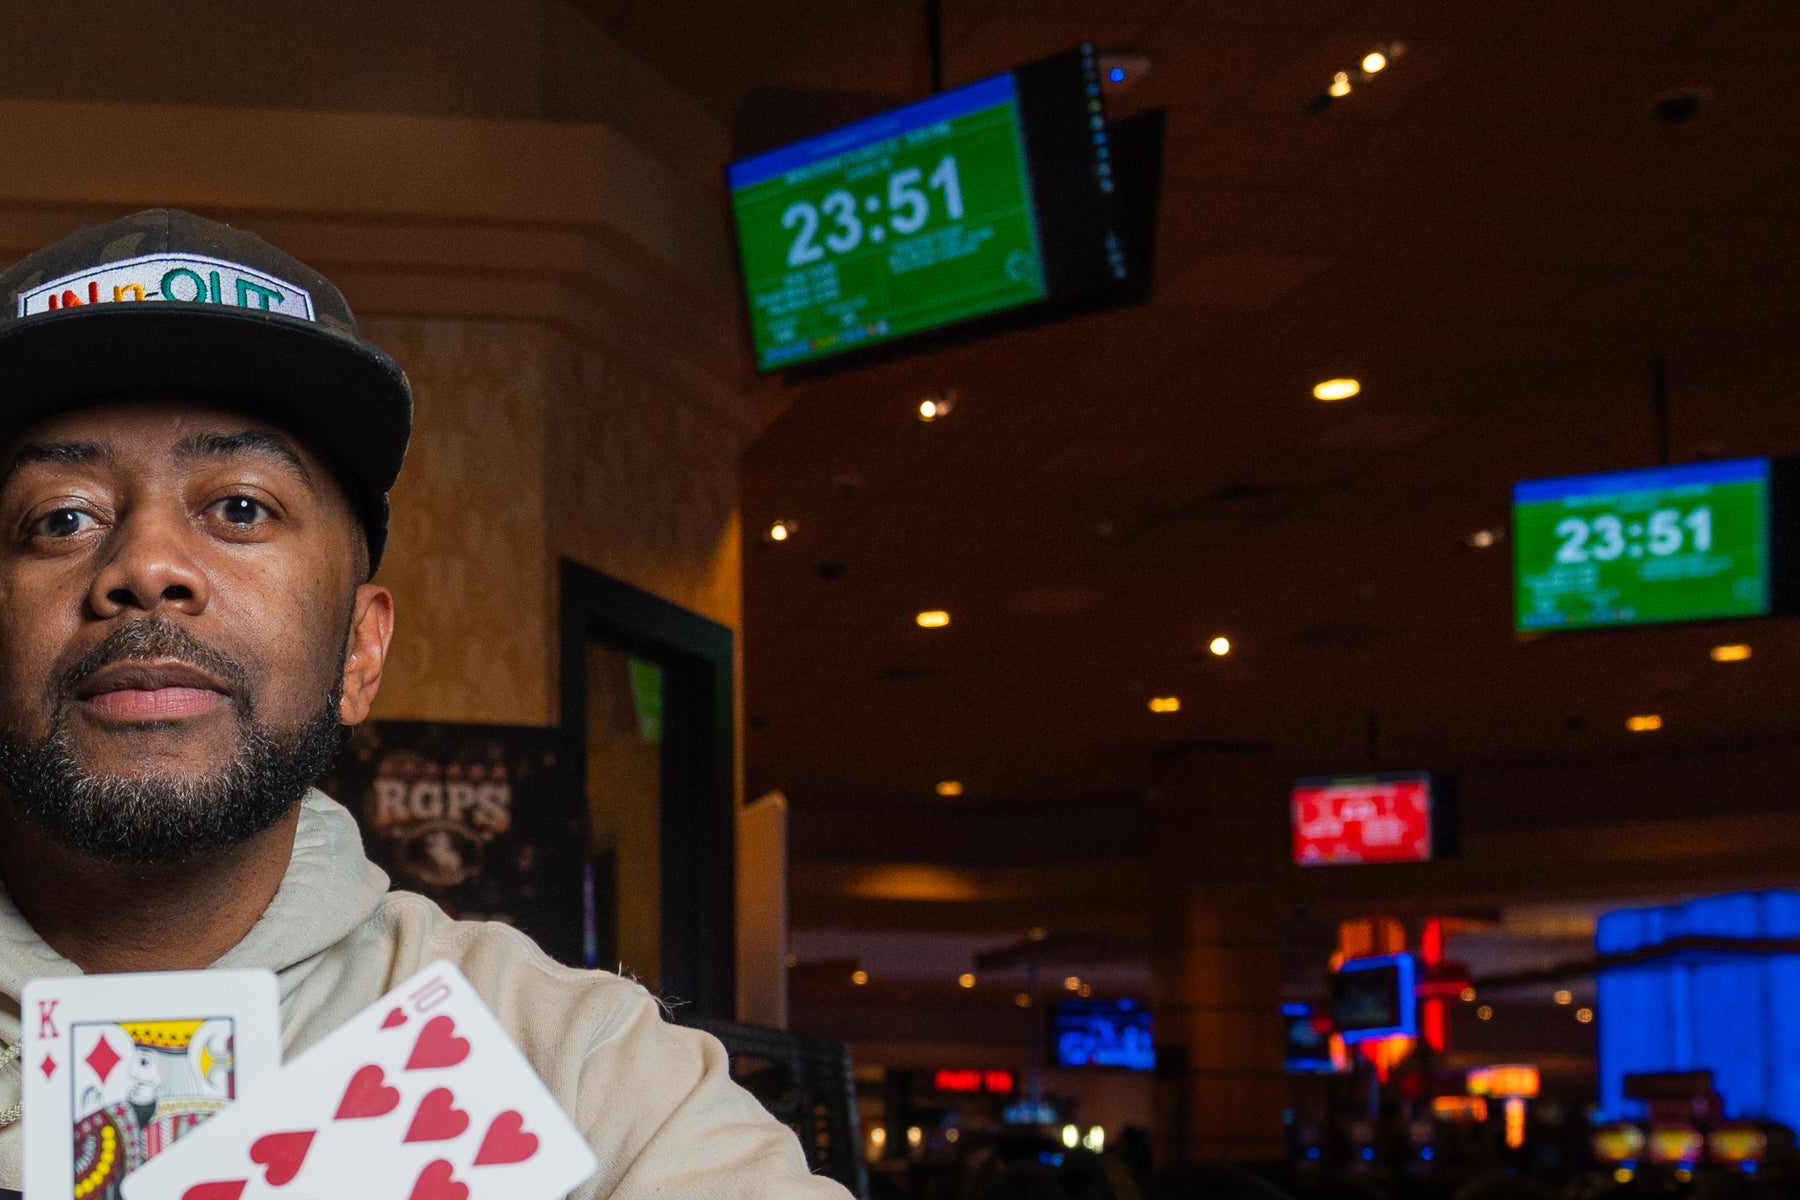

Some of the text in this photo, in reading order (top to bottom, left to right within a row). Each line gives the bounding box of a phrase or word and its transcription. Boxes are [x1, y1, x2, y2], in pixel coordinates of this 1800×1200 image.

[781, 154, 965, 267] 23:51
[1554, 505, 1712, 565] 23:51
[374, 779, 512, 832] RGPS
[37, 1000, 60, 1039] K
[409, 976, 451, 1013] 10
